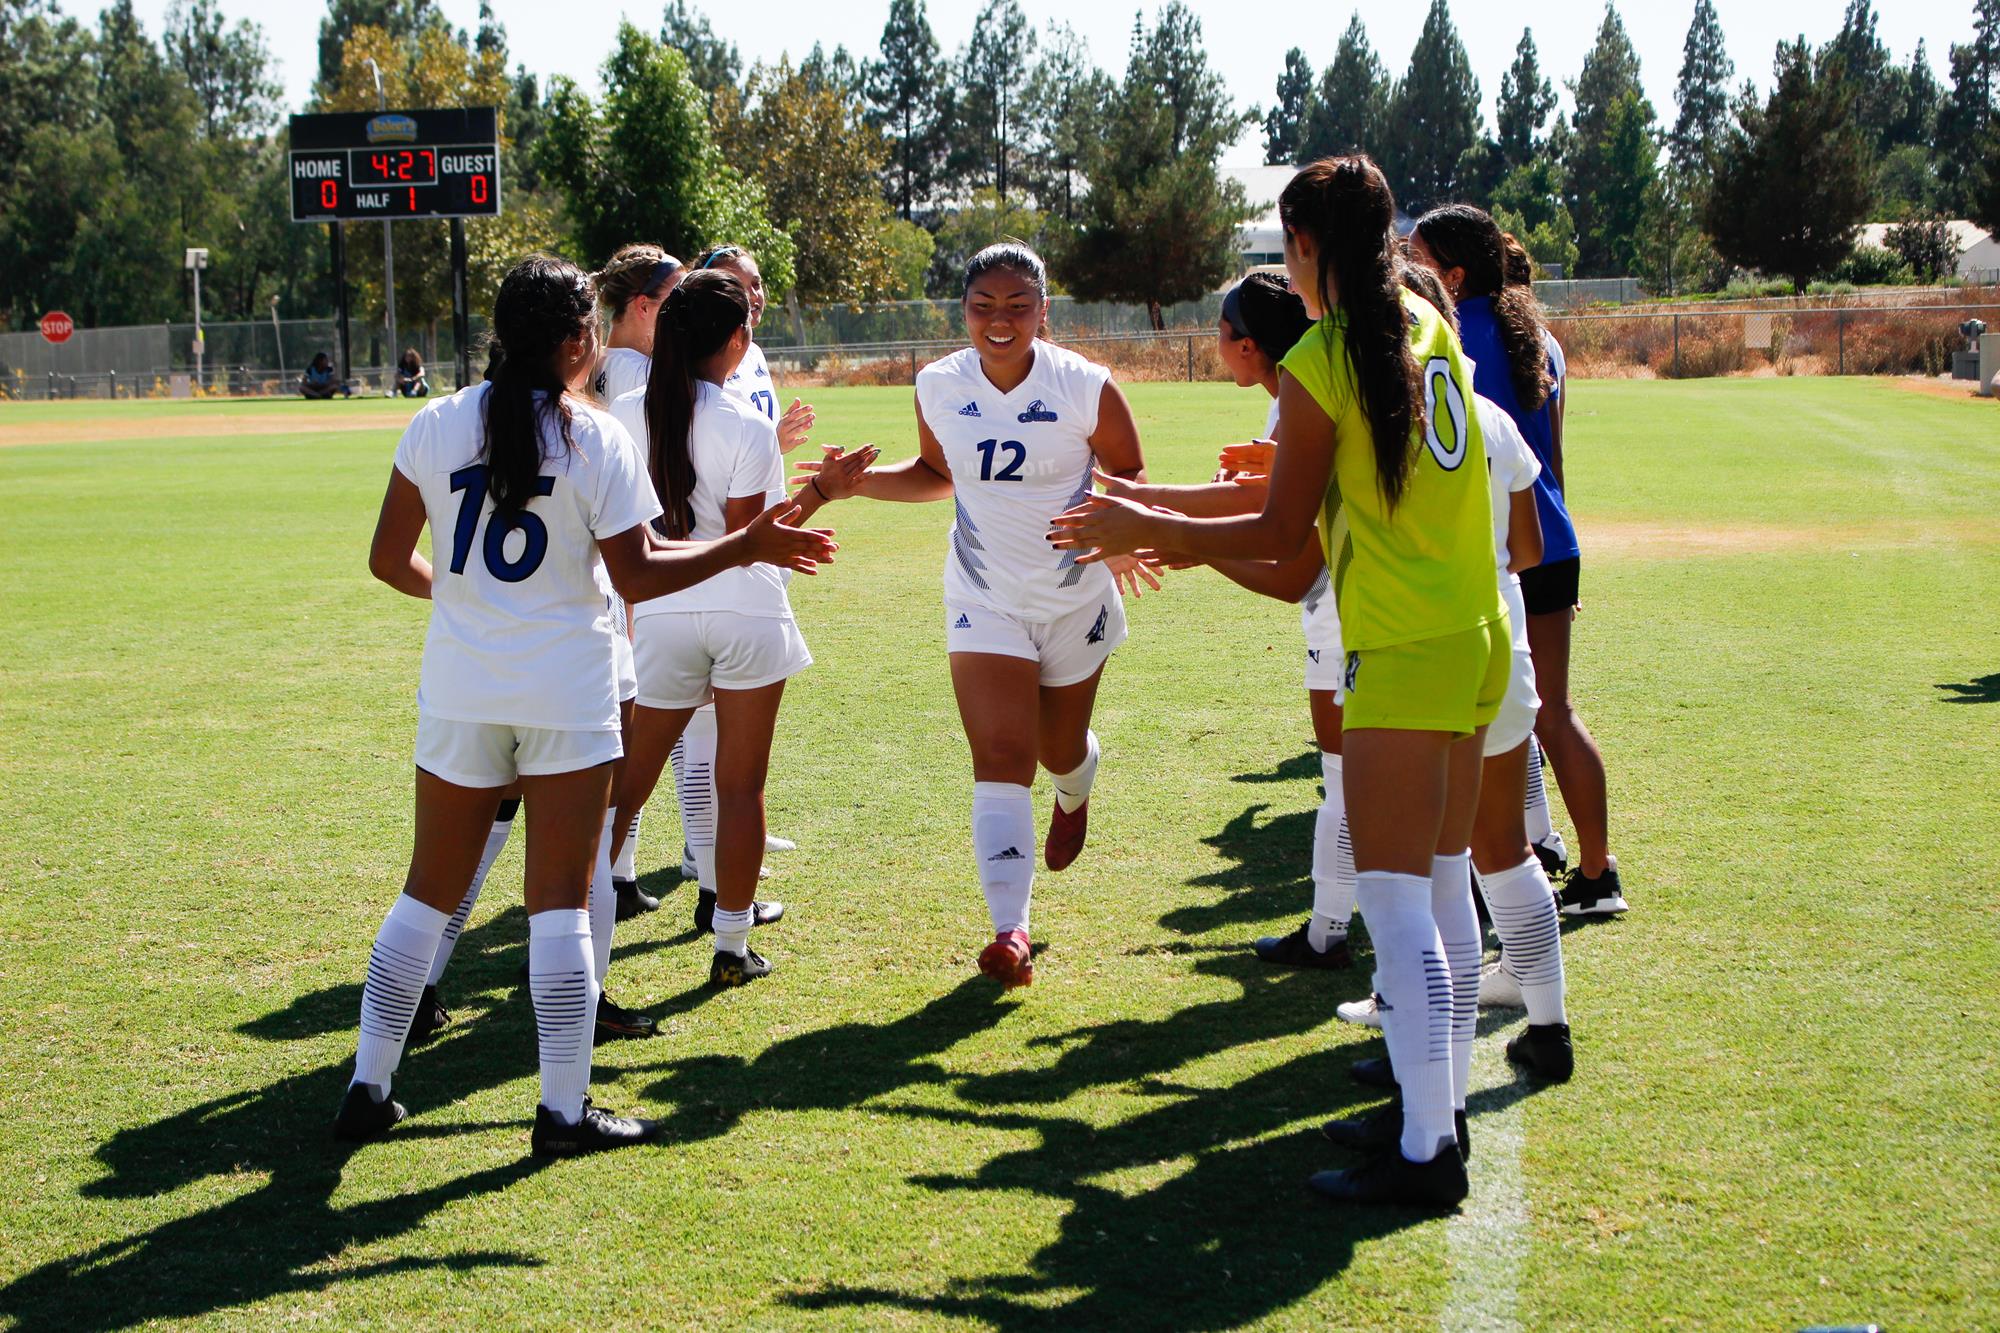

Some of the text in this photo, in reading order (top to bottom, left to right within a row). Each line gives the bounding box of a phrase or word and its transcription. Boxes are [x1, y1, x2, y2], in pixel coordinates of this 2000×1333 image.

[294, 160, 341, 178] HOME
[372, 151, 434, 179] 4:27
[441, 154, 494, 174] GUEST
[321, 180, 337, 209] 0
[356, 193, 390, 209] HALF
[408, 186, 416, 211] 1
[471, 175, 488, 203] 0
[42, 320, 72, 335] STOP
[750, 390, 773, 421] 17
[976, 438, 1027, 481] 12
[449, 463, 557, 583] 16
